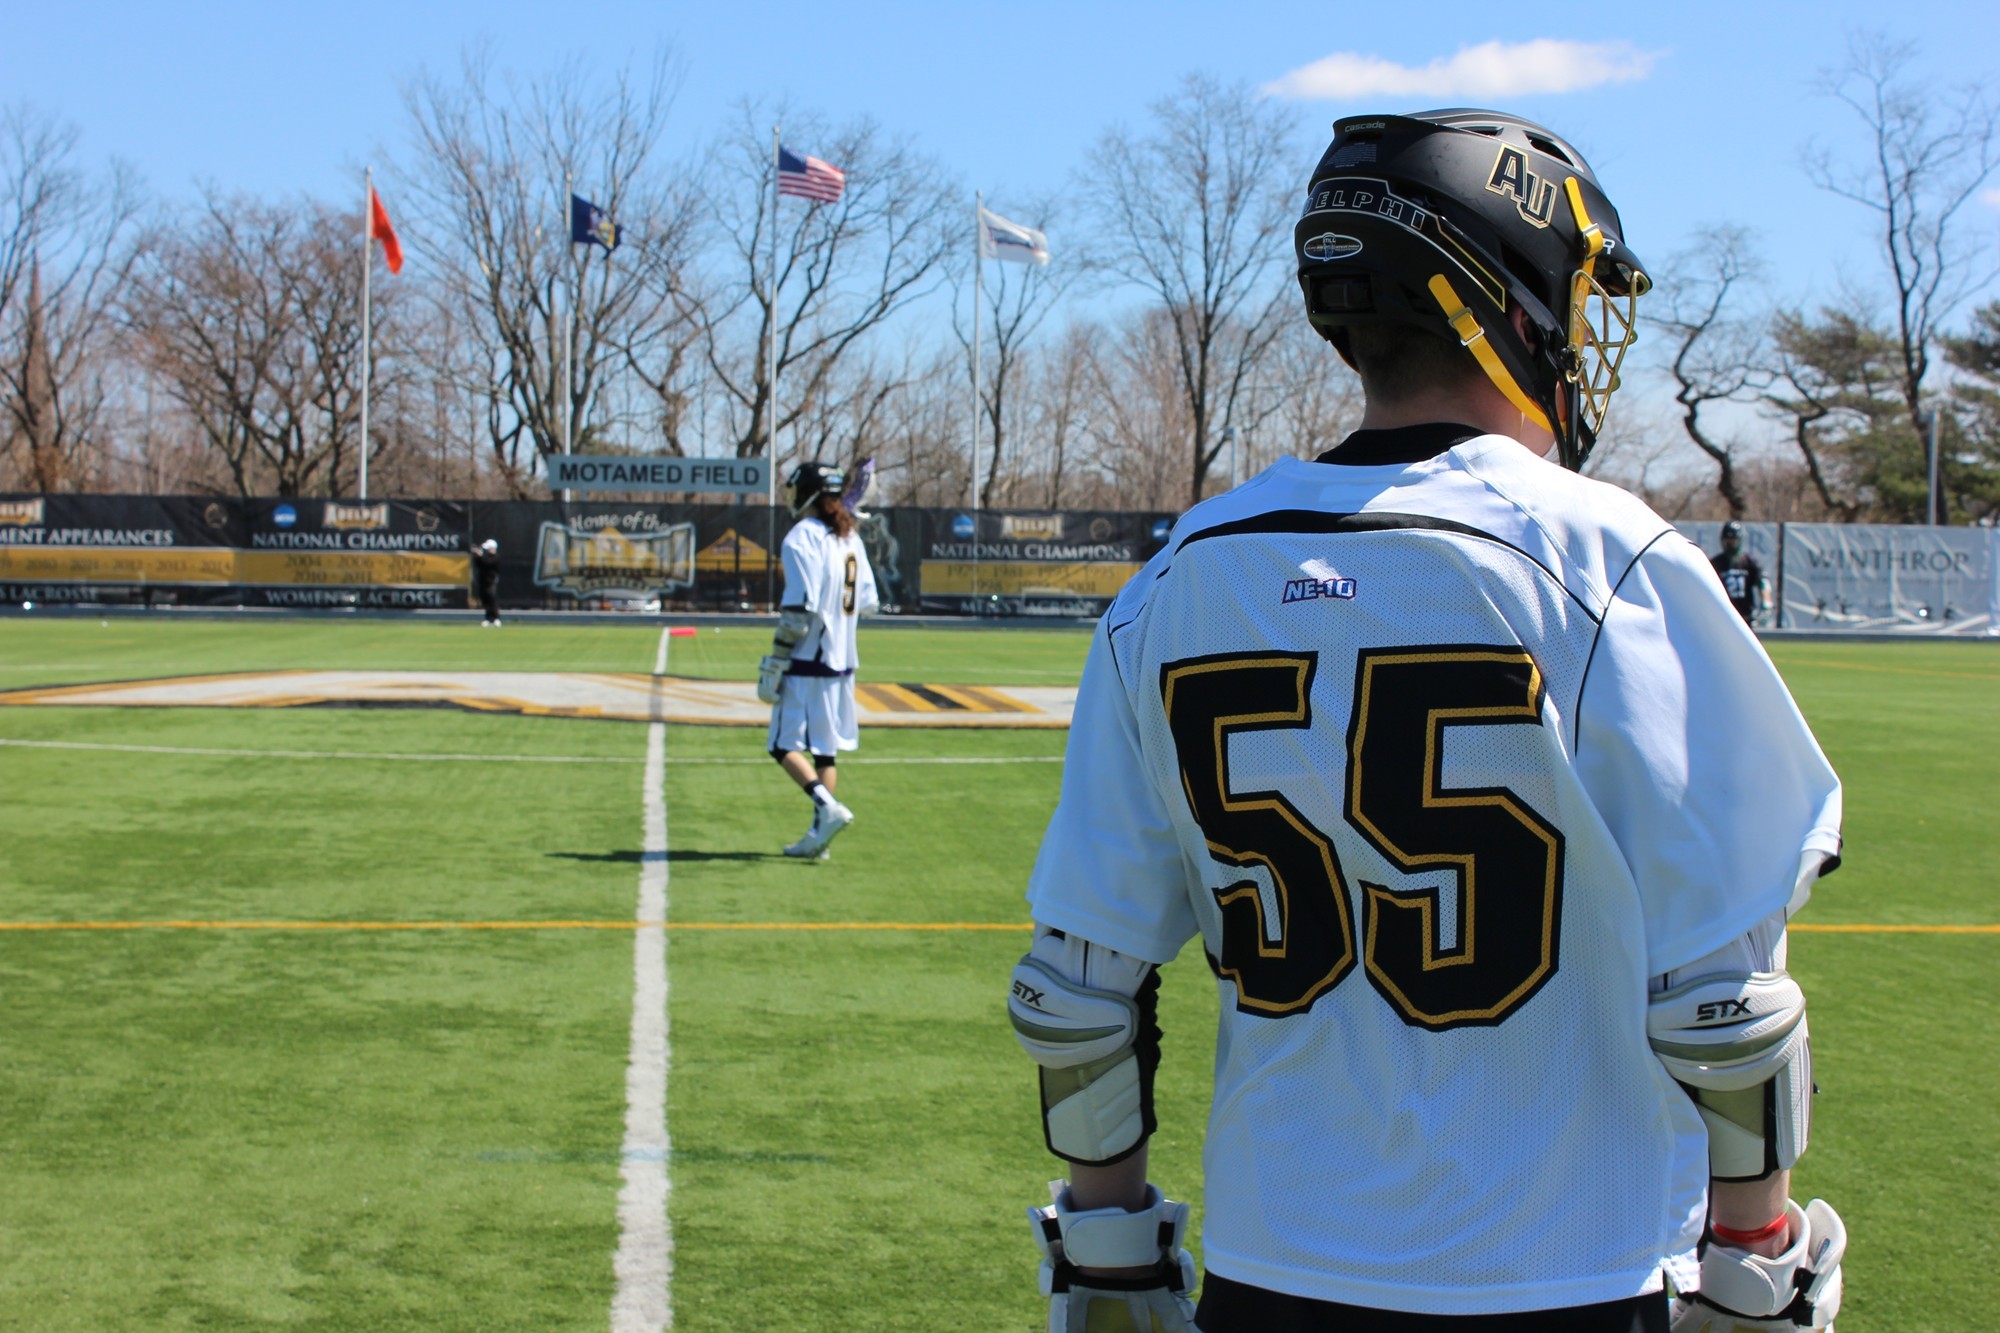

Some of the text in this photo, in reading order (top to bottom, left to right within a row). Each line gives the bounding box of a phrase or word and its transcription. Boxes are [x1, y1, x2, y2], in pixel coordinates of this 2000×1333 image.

[1345, 121, 1386, 133] cascade
[1485, 143, 1558, 230] AU
[559, 463, 760, 486] MOTAMED FIELD
[48, 528, 174, 546] APPEARANCES
[252, 532, 460, 550] NATIONAL CHAMPIONS
[931, 543, 1131, 561] NATIONAL CHAMPIONS
[1807, 549, 1970, 573] WINTHROP
[841, 552, 858, 616] 9
[1282, 578, 1357, 604] NE-10
[265, 589, 354, 605] WOMEN
[1160, 644, 1566, 1031] 55
[1011, 980, 1046, 1007] STX
[1695, 998, 1753, 1022] STX
